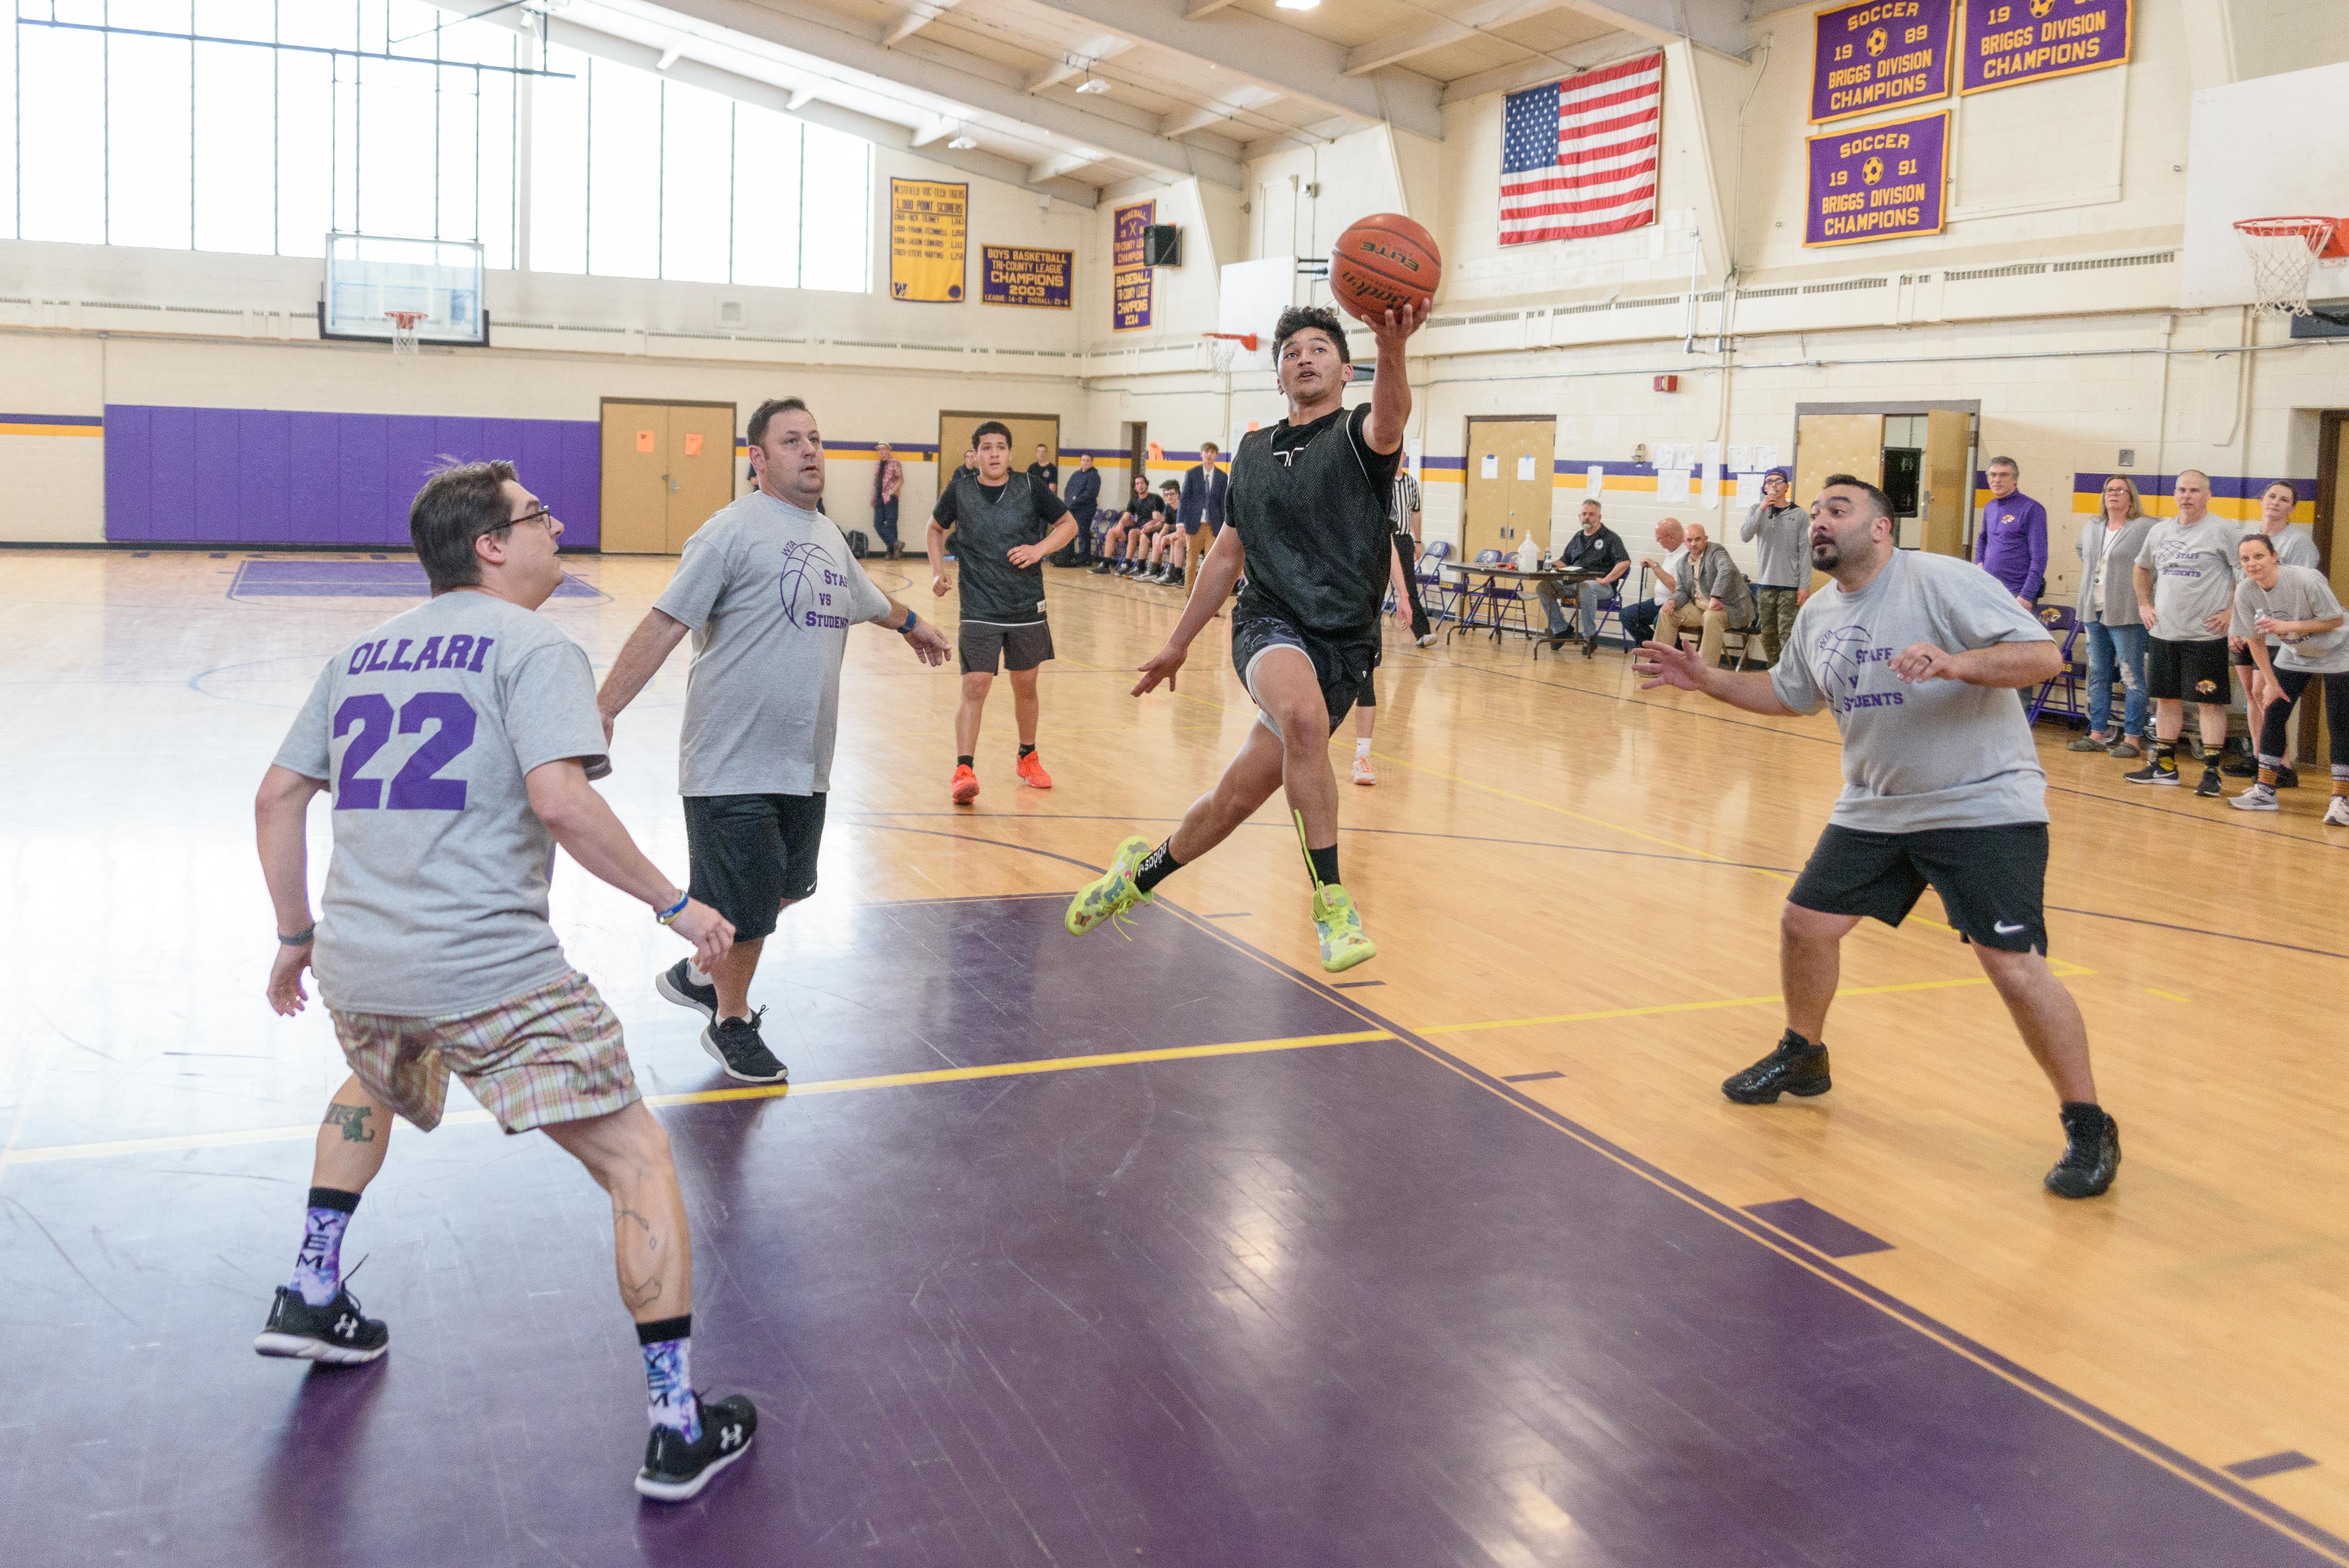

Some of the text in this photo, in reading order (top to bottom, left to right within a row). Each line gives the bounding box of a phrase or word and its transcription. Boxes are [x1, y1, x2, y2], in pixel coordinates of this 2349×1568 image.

[1848, 2, 1919, 31] SOCCER
[1988, 5, 2011, 25] 19
[1834, 25, 1928, 61] 19 89
[1981, 10, 2106, 57] BRIGGS DIVISION
[1828, 49, 1932, 89] BRIGGS DIVISION
[1983, 37, 2100, 79] CHAMPIONS
[1831, 73, 1926, 110] CHAMPIONS
[1840, 133, 1910, 158] SOCCER
[1829, 159, 1917, 187] 19 91
[894, 185, 919, 196] WESTFIELD
[949, 189, 965, 199] TIGERS
[1822, 183, 1925, 215] BRIGGS DIVISION
[896, 199, 963, 214] 1,000 POINT SCORERS
[1120, 209, 1146, 225] BASEBALL
[1825, 207, 1919, 235] CHAMPIONS
[987, 248, 1067, 264] BOYS BASKETBALL
[992, 260, 1063, 274] TRI-COUNTY LEAGUE
[1360, 241, 1419, 272] ELITE
[990, 271, 1063, 287] CHAMPIONS
[1009, 285, 1045, 297] 2003
[1117, 271, 1150, 287] BASEBALL
[1342, 270, 1411, 310] Baden
[1117, 299, 1148, 314] CHAMPIONS
[781, 541, 797, 556] WTA
[1818, 629, 1833, 649] WTA
[347, 634, 494, 675] OLLARI
[1856, 648, 1893, 665] STAFF
[1848, 675, 1859, 688] V
[333, 692, 477, 811] 22
[1145, 842, 1167, 871] adidas
